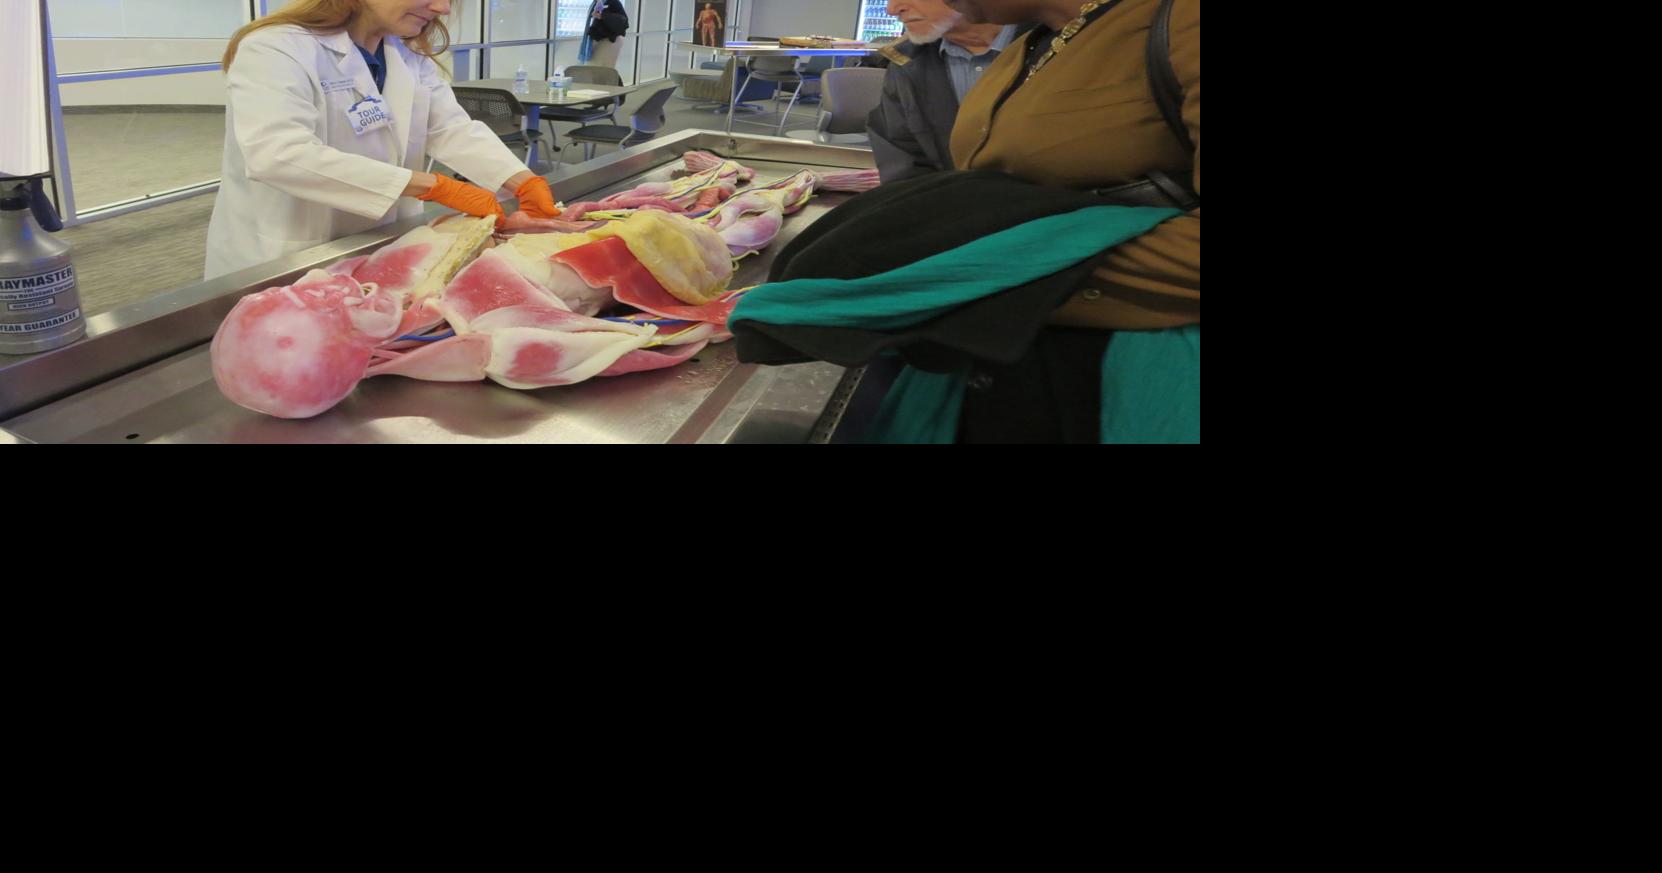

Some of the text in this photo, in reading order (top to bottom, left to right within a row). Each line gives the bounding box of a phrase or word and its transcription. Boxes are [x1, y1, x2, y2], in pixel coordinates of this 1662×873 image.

[358, 106, 381, 118] TOUR
[360, 112, 385, 126] GUIDE
[24, 312, 76, 330] GUARANTEE
